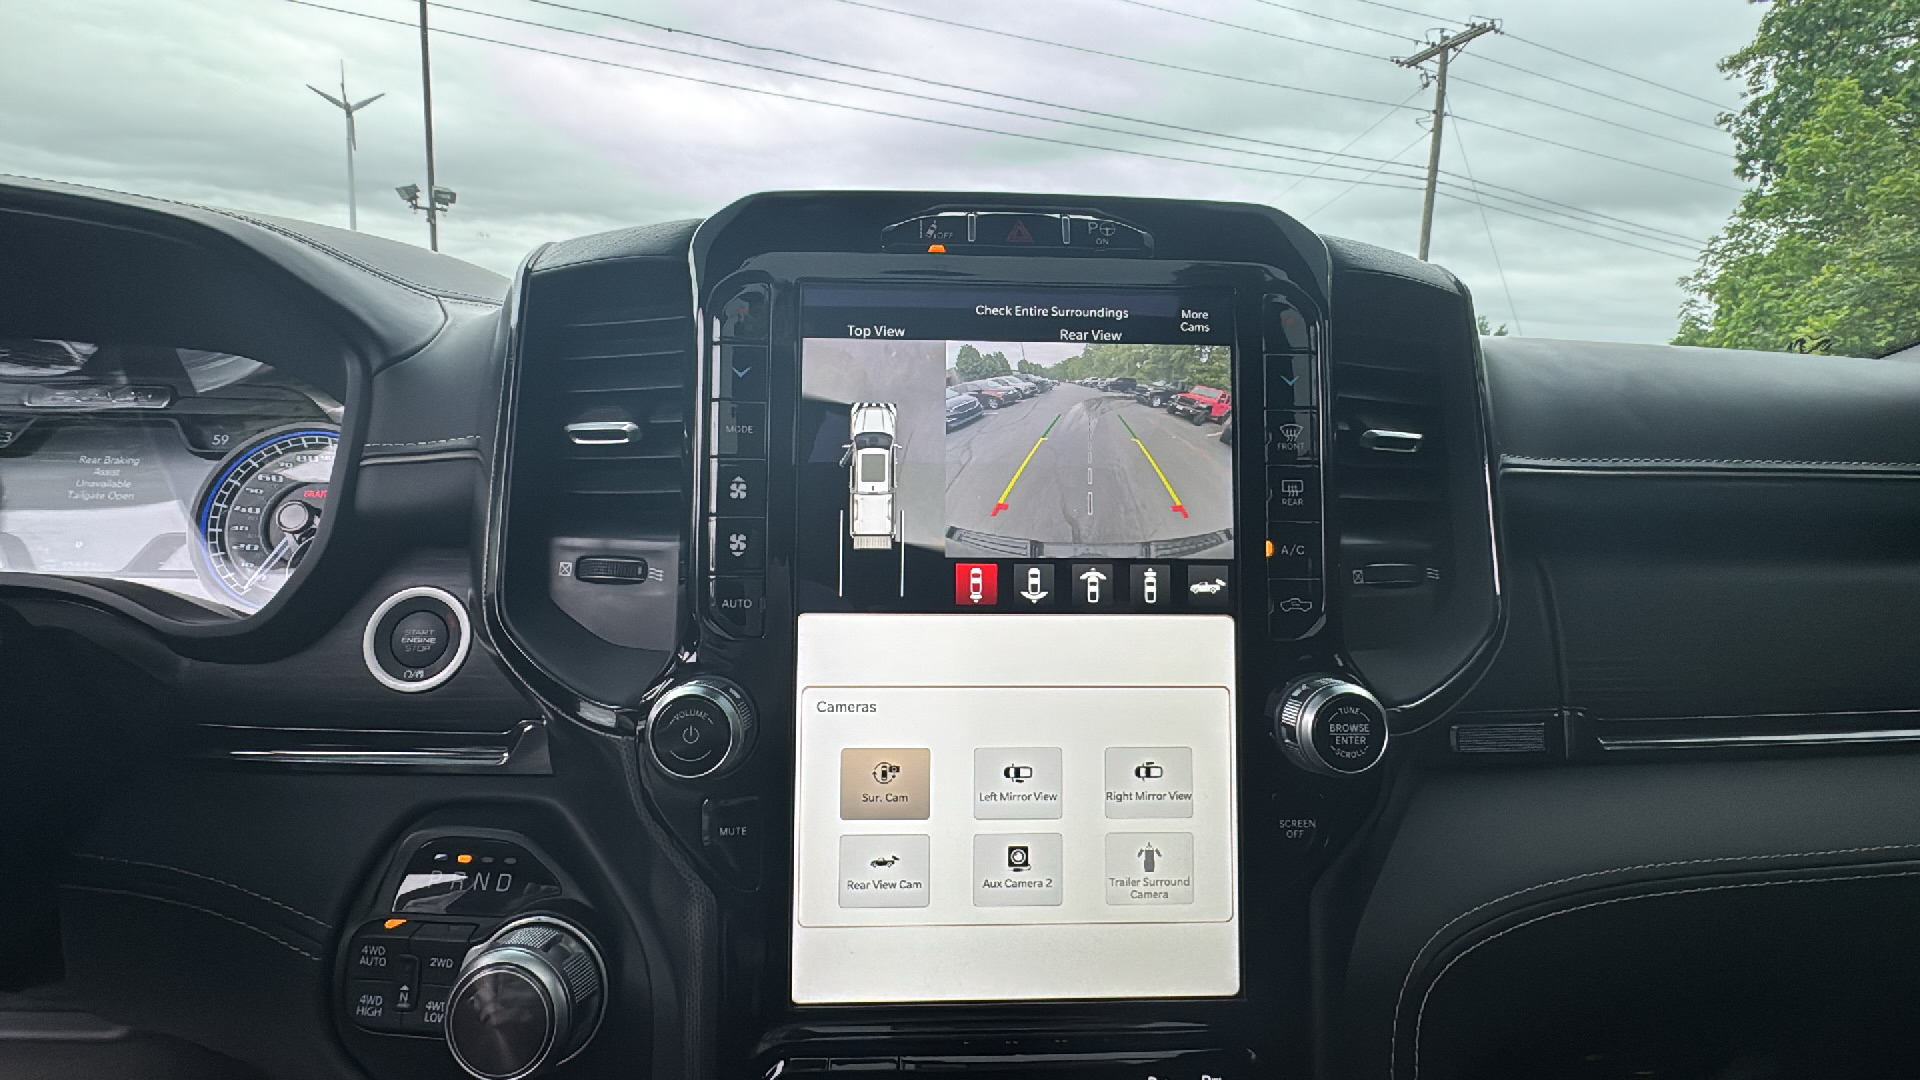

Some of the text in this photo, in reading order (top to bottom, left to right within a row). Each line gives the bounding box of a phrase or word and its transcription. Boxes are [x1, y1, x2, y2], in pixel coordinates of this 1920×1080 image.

[1088, 222, 1098, 235] P
[936, 232, 954, 240] OFF
[975, 306, 1129, 320] Check Entire Surroundings
[1181, 310, 1209, 320] More
[847, 325, 906, 340] Top View
[1180, 322, 1210, 333] Cams
[1060, 330, 1123, 341] Rear View
[725, 425, 754, 435] MODE
[0, 431, 13, 443] 3
[211, 434, 230, 446] 59
[1277, 442, 1305, 451] FRONT
[79, 455, 141, 466] Rear Braking
[93, 467, 121, 477] Assist
[258, 473, 284, 483] 60
[75, 479, 132, 489] Unavailable
[67, 490, 135, 501] Tailgate Open
[303, 489, 328, 499] BRAK
[1281, 497, 1304, 507] REAR
[1280, 544, 1305, 556] A/C
[721, 599, 753, 609] AUTO
[405, 645, 431, 653] STOP
[816, 700, 877, 714] Cameras
[1338, 706, 1361, 715] TUNE
[674, 709, 709, 721] VOLUME
[1329, 723, 1370, 733] BROWSE
[1335, 736, 1367, 745] ENTER
[1335, 748, 1366, 759] SCROLL
[861, 792, 909, 803] Sur. Cam
[979, 791, 1058, 802] Left Mirror View
[1106, 791, 1192, 803] Right Mirror View
[1279, 819, 1316, 829] SCREEN
[719, 826, 747, 836] MUTE
[1286, 830, 1304, 839] OFF
[847, 879, 922, 891] Rear View Cam
[982, 878, 1053, 889] Aux Camera 2
[1109, 876, 1191, 888] Trailer Surround
[1130, 889, 1169, 900] Camera
[361, 945, 386, 956] 4WD
[359, 956, 387, 967] AUTO
[429, 957, 454, 969] 2WD
[359, 994, 383, 1006] 4WD
[400, 992, 409, 1002] N
[356, 1006, 382, 1017] HIGH
